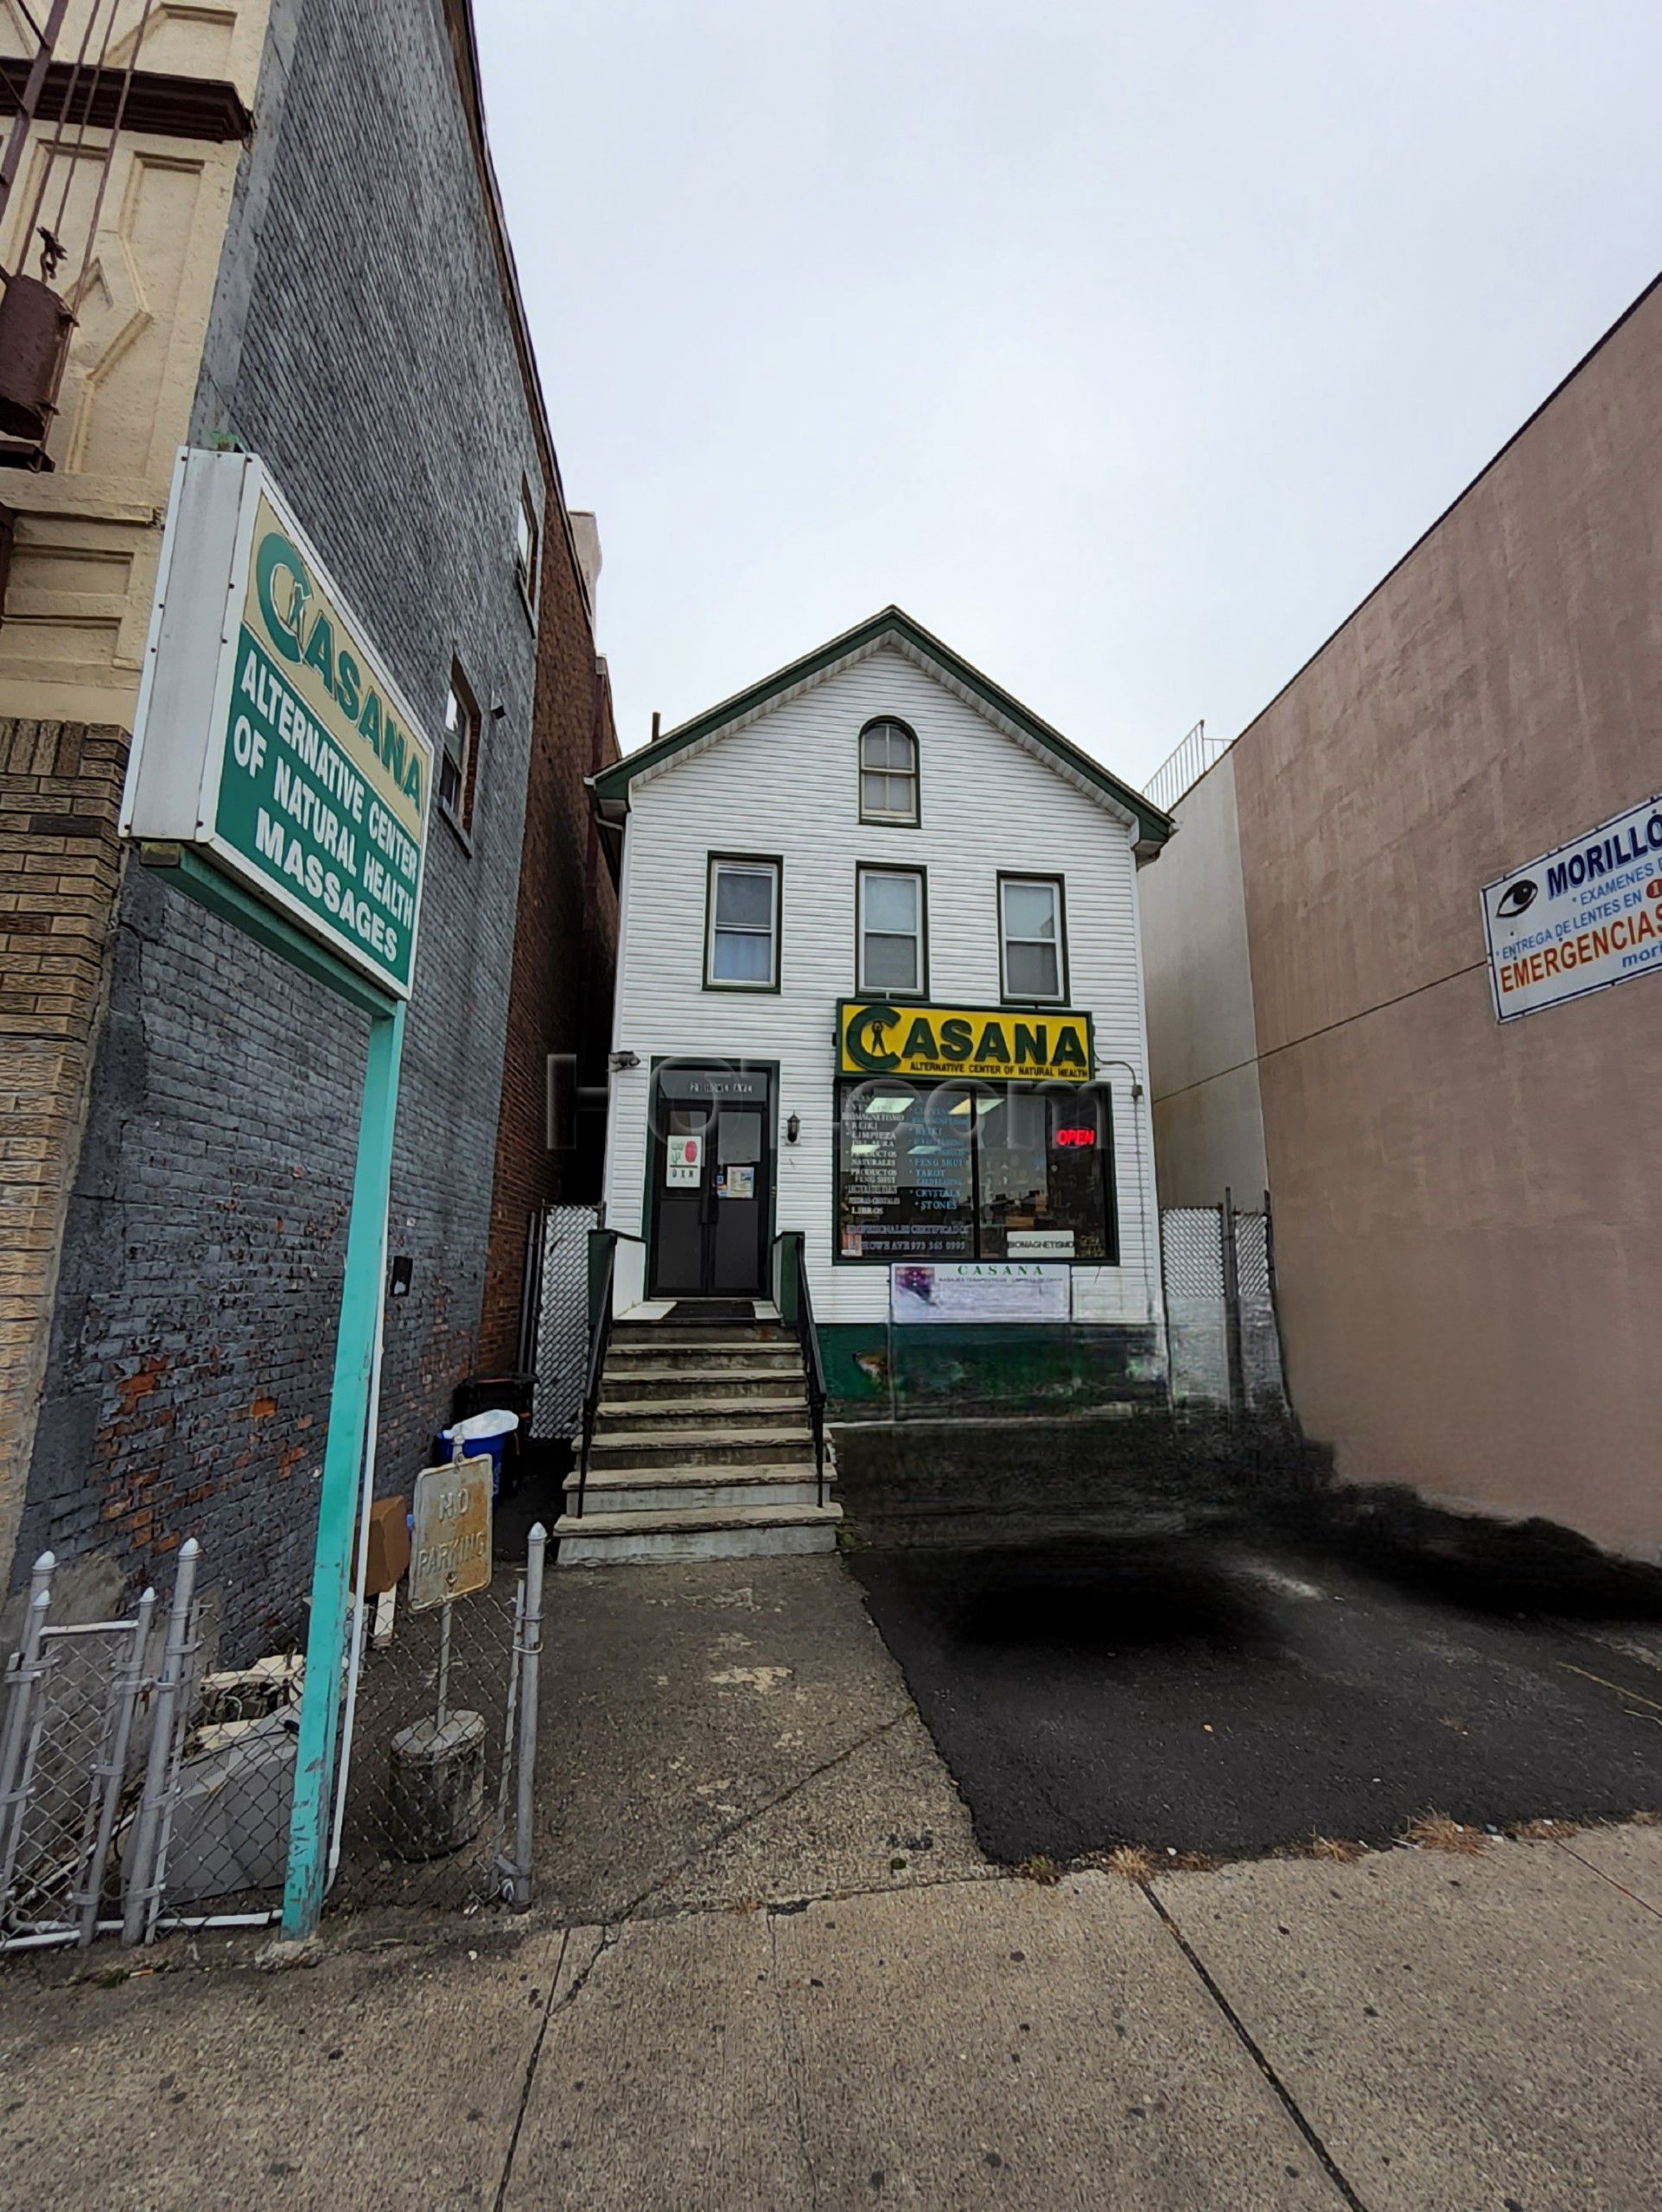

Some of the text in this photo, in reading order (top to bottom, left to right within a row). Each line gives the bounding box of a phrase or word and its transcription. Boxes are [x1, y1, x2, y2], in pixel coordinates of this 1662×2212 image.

[256, 532, 421, 817] CASANA
[241, 650, 417, 885] ALTERNATIVE CENTER
[234, 721, 413, 931] OF NATURAL HEALTH
[255, 807, 397, 963] MASSAGES
[1581, 862, 1654, 906] EXAMENES
[1502, 929, 1553, 959] ENTREGA
[1556, 919, 1571, 938] DE
[1573, 901, 1621, 930] LENTES
[1624, 889, 1642, 908] EN
[846, 1006, 1087, 1071] CASANA
[910, 1061, 1088, 1078] ALTERNATIVE CENTER OF NATURAL HEALTH
[851, 1132, 897, 1141] LIMPIEZA
[1056, 1128, 1095, 1147] OPEN
[916, 1169, 945, 1178] TAROT
[851, 1205, 883, 1215] LIBROS
[920, 1199, 958, 1211] STONES
[911, 1240, 927, 1250] 973
[958, 1265, 1044, 1276] CASANA
[438, 1487, 469, 1523] NO
[417, 1530, 487, 1578] PARKING
